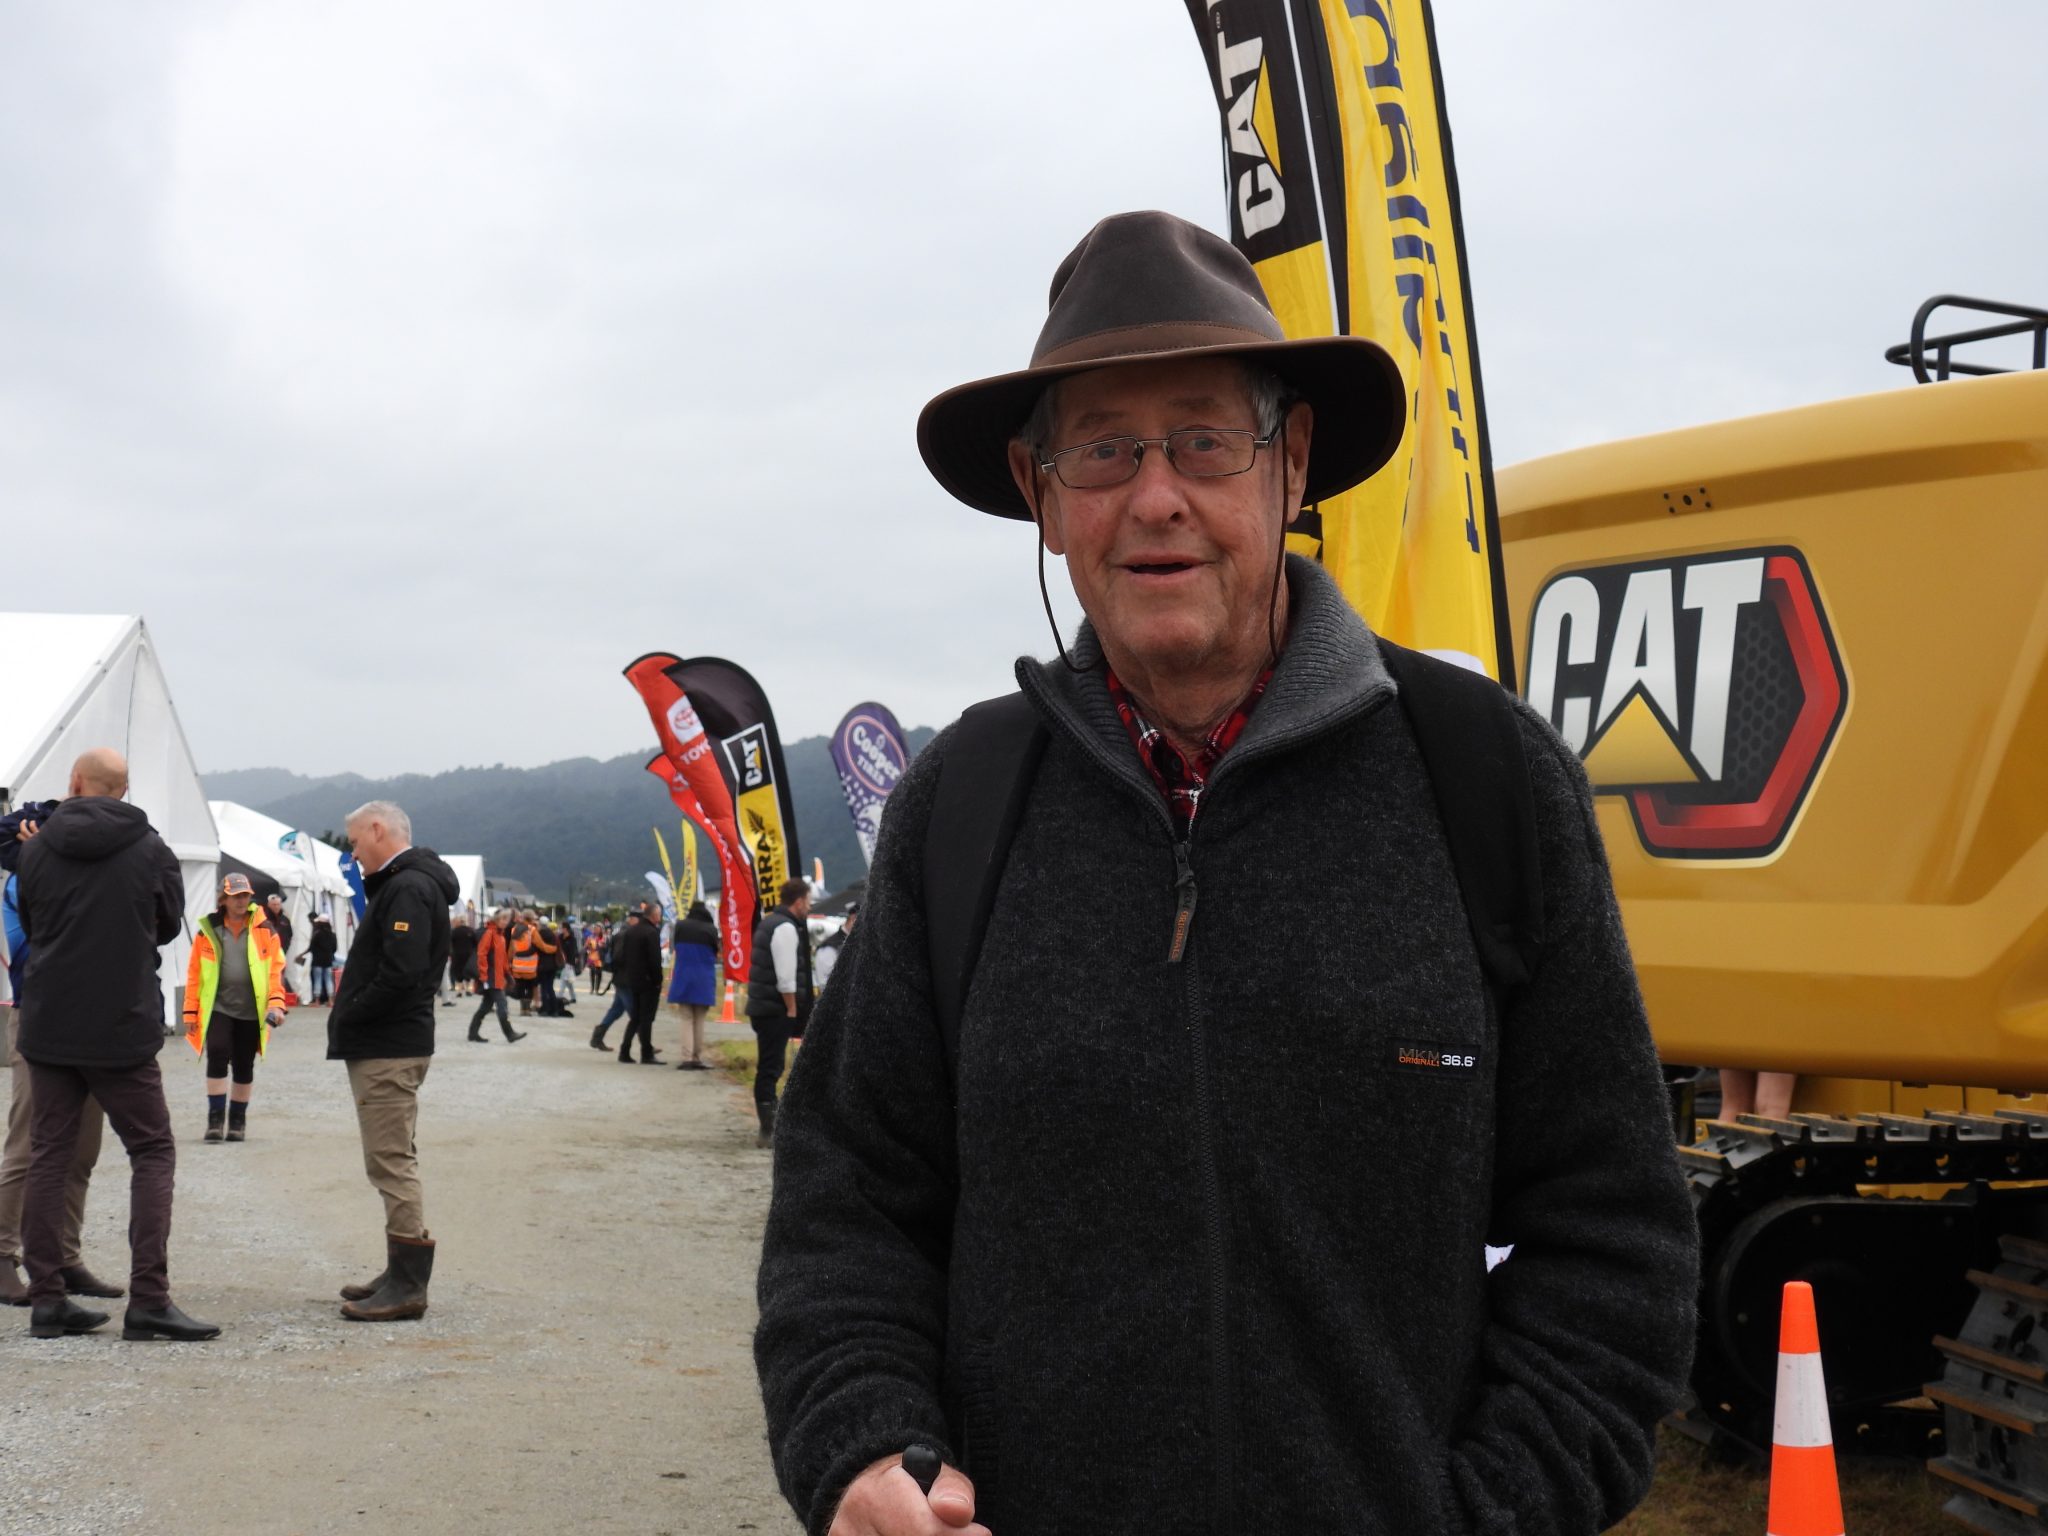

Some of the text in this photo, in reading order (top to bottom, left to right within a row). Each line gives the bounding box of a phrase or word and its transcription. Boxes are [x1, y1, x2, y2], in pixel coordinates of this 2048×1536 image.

[1217, 31, 1286, 240] CAT
[1528, 557, 1765, 782] CAT
[741, 738, 763, 787] CAT
[853, 725, 900, 779] Cooper
[757, 834, 776, 914] ERRA
[1399, 1047, 1440, 1061] MKM
